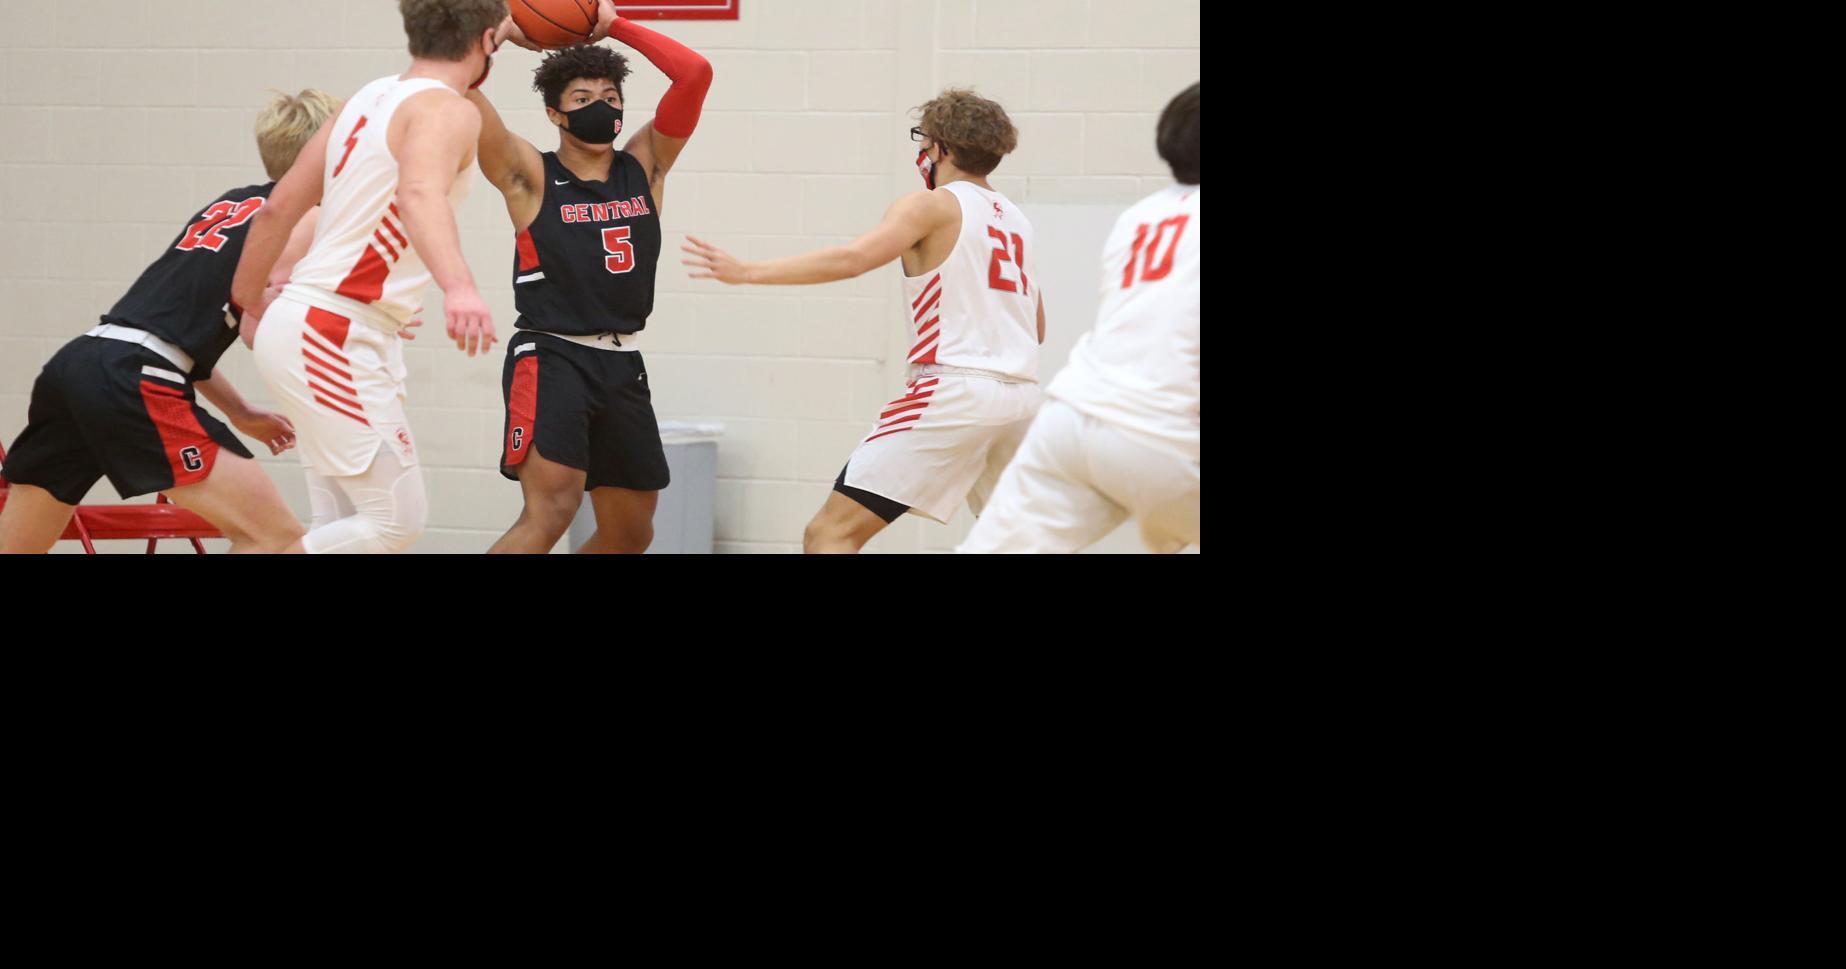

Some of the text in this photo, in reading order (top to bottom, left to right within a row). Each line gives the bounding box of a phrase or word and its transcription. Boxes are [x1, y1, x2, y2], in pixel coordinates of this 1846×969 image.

[175, 196, 266, 252] 22
[560, 195, 650, 223] CENTRAL
[601, 225, 635, 274] 5
[986, 223, 1028, 296] 21
[1121, 213, 1190, 289] 10
[179, 445, 204, 472] C
